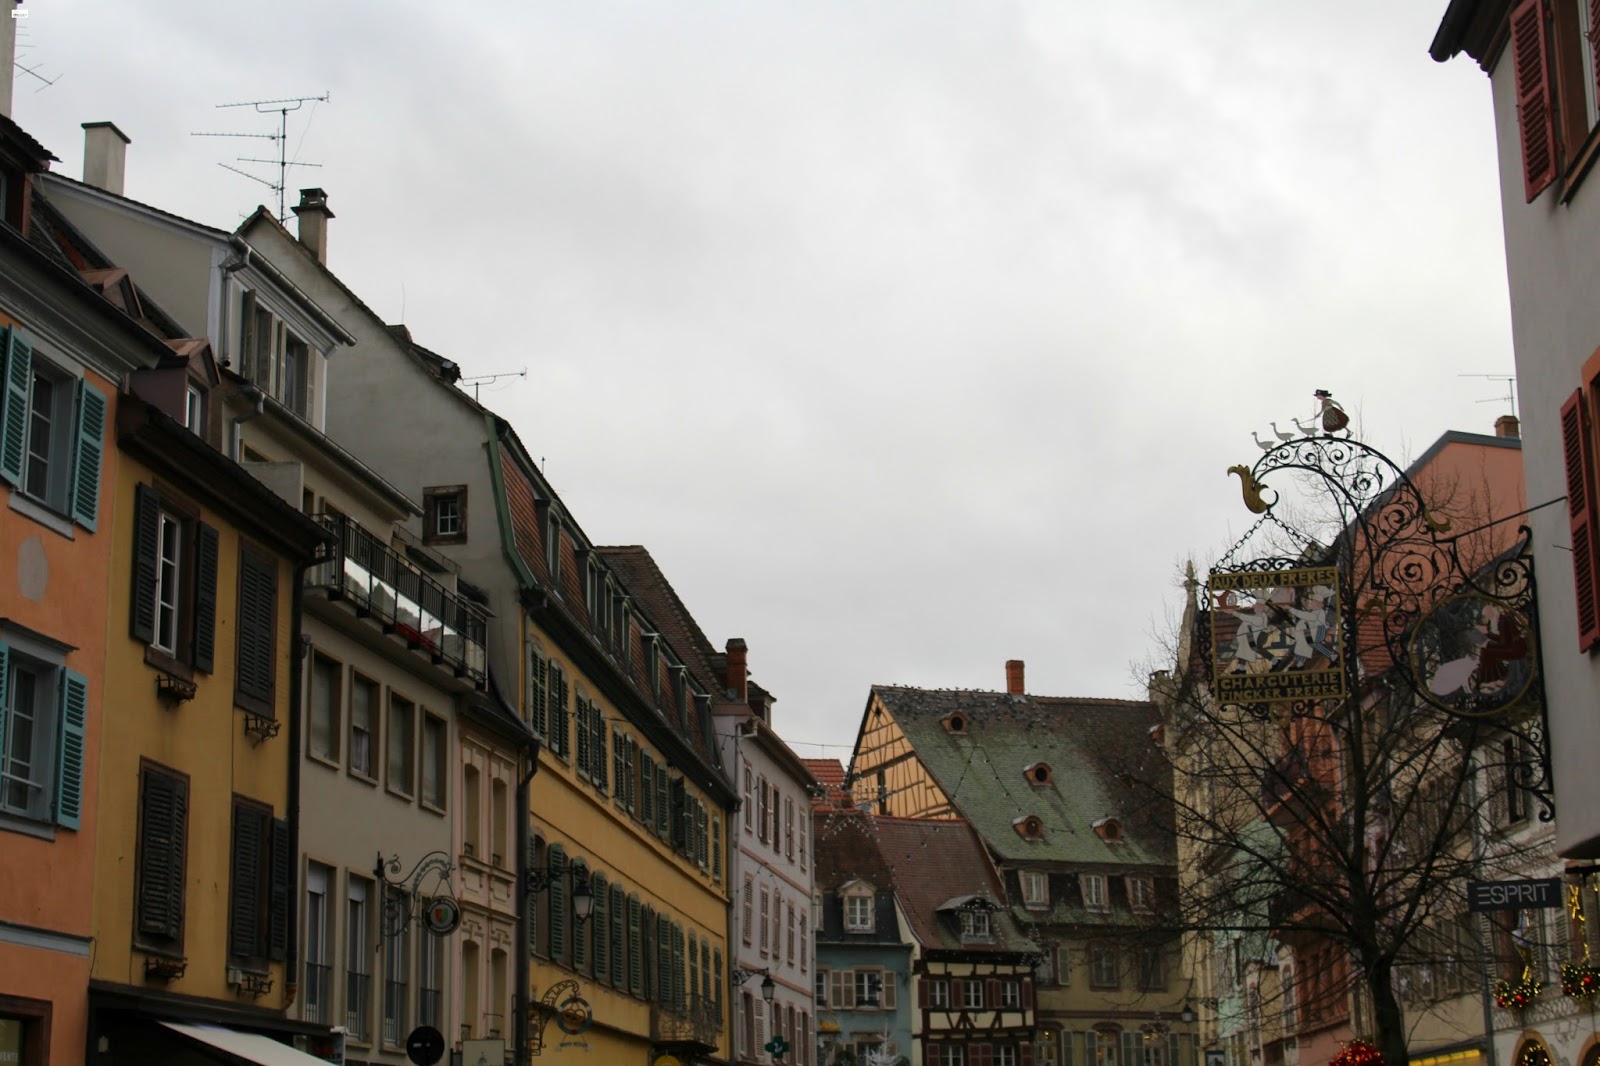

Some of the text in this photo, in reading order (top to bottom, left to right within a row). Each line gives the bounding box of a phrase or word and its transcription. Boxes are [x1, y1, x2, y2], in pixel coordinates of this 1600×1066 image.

[1213, 571, 1335, 589] AUX DEUX FRERES
[1220, 672, 1338, 688] CHARCUTERIE
[1222, 685, 1338, 702] FINCKER FRERES
[1477, 883, 1550, 904] ESPRIT
